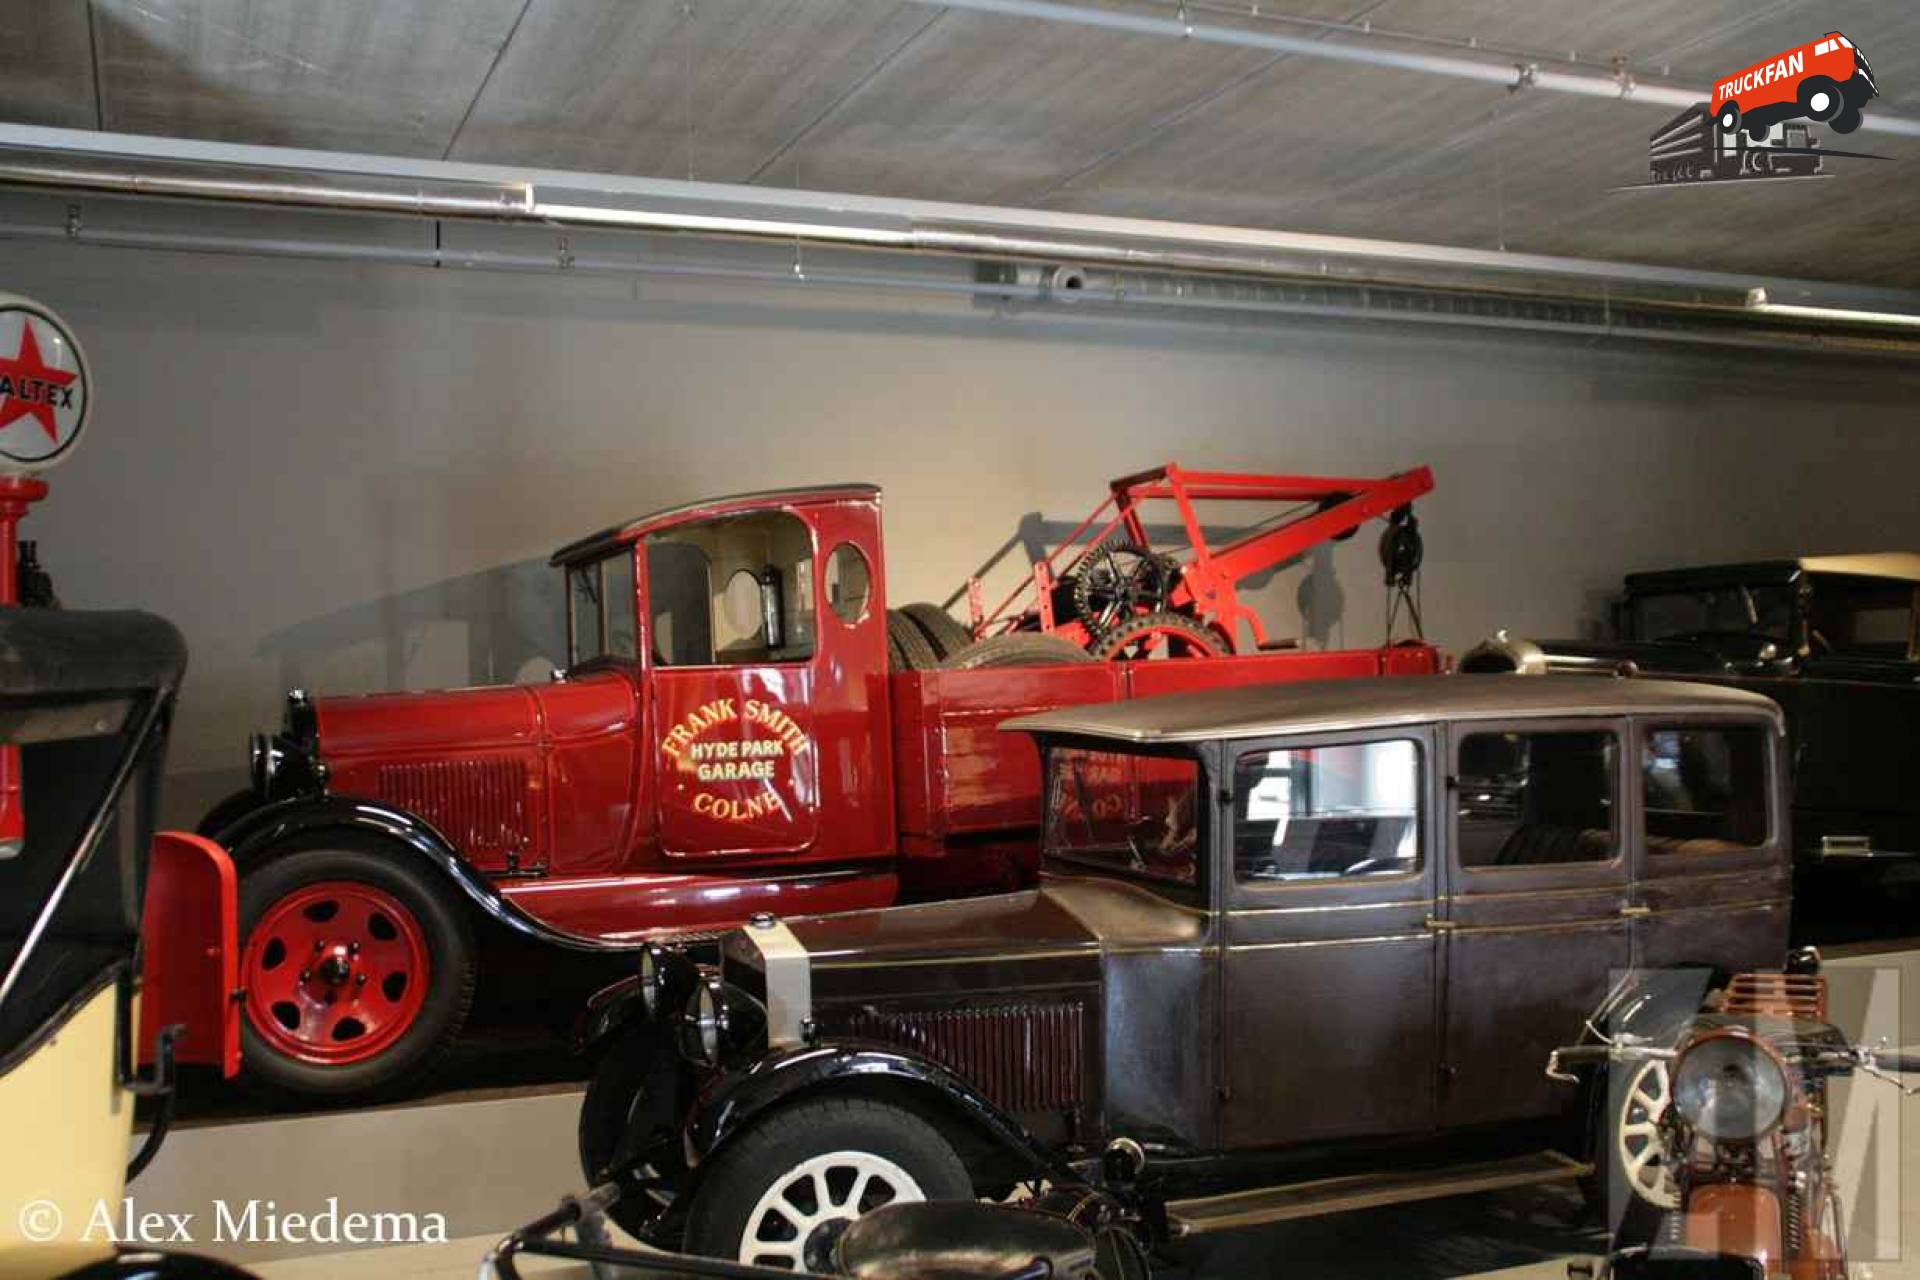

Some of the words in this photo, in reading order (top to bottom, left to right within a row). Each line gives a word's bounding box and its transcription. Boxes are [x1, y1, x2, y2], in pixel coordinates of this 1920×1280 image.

[0, 375, 73, 410] ALTEX
[662, 698, 737, 757] FRANK
[745, 699, 811, 757] SMITH
[691, 742, 738, 758] HYDE
[742, 740, 784, 758] PARK
[699, 761, 775, 780] GARAGE
[694, 792, 781, 819] COLNE
